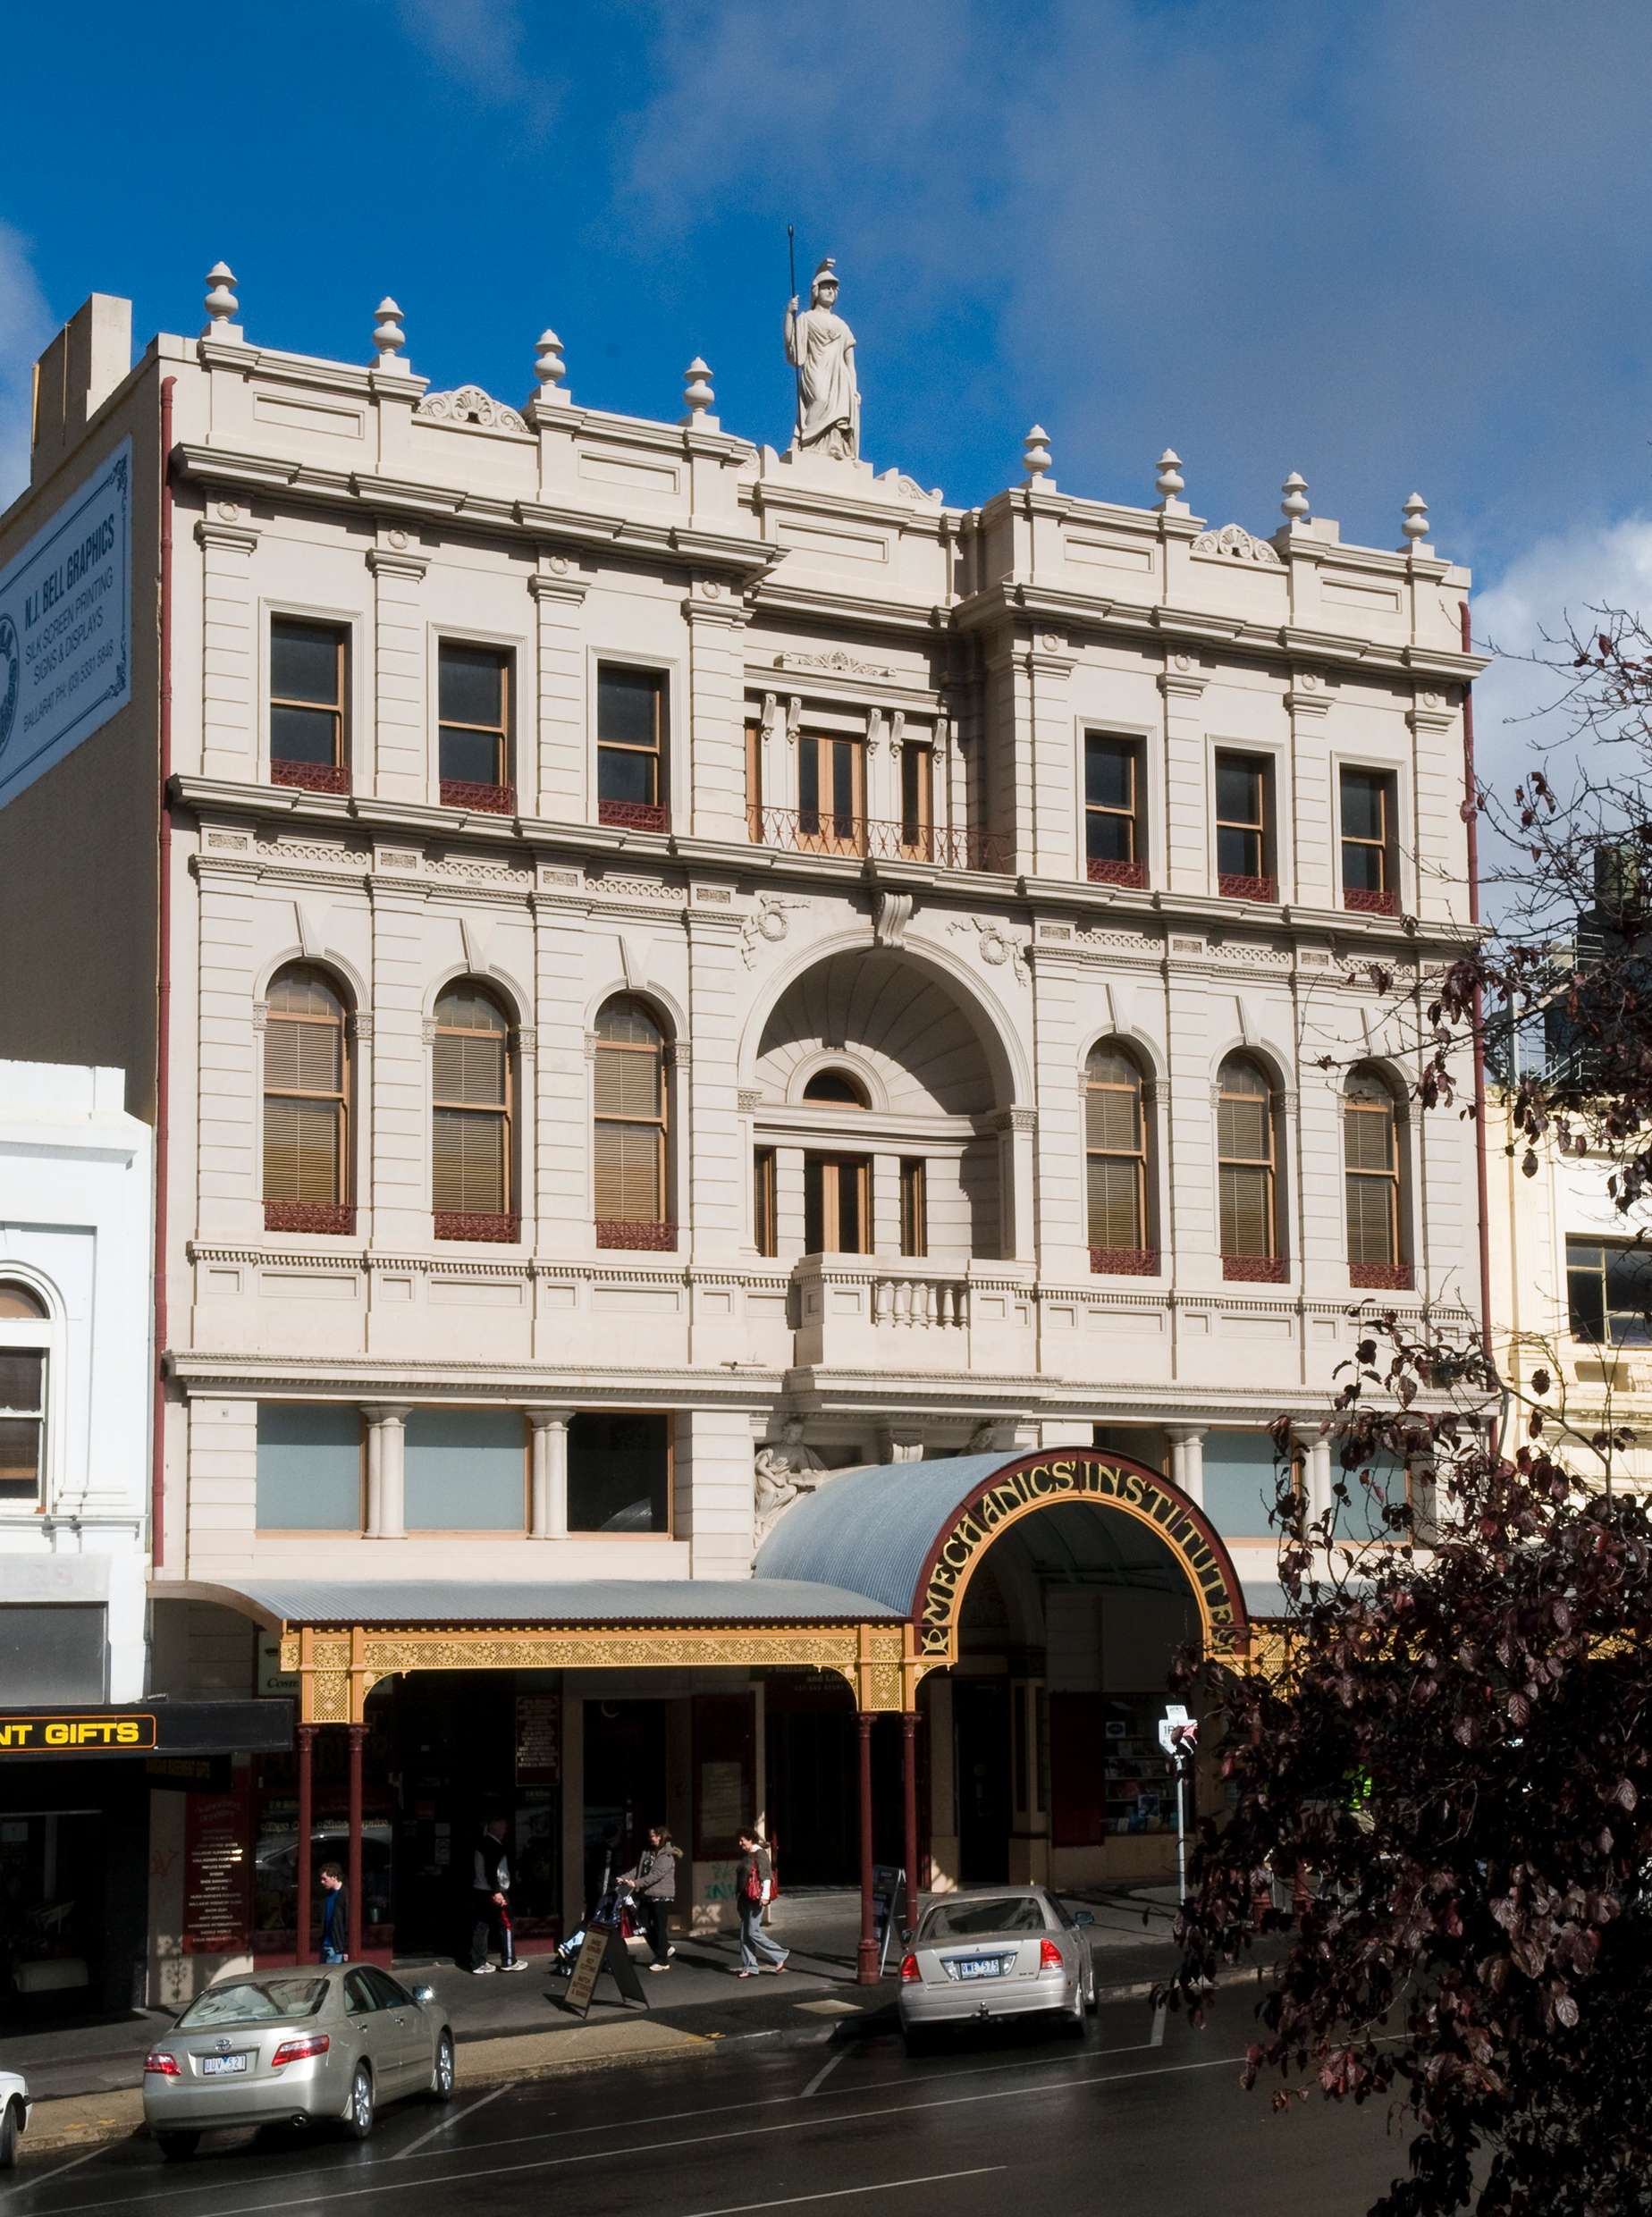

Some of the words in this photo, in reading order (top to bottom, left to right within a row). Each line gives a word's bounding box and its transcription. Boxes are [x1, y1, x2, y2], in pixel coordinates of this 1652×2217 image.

[25, 590, 40, 631] N.J.
[42, 565, 64, 614] BELL
[66, 513, 114, 590] GRAPHICS
[25, 635, 42, 665] SILK
[43, 607, 73, 651] SCREEN
[75, 566, 114, 619] PRINTING
[33, 648, 56, 686] SIGNS
[65, 605, 104, 661] DISPLAYS
[1083, 1461, 1234, 1626] INSTITUTE
[0, 1724, 33, 1746] NT
[45, 1722, 139, 1745] GIFTS
[229, 2057, 244, 2069] 521
